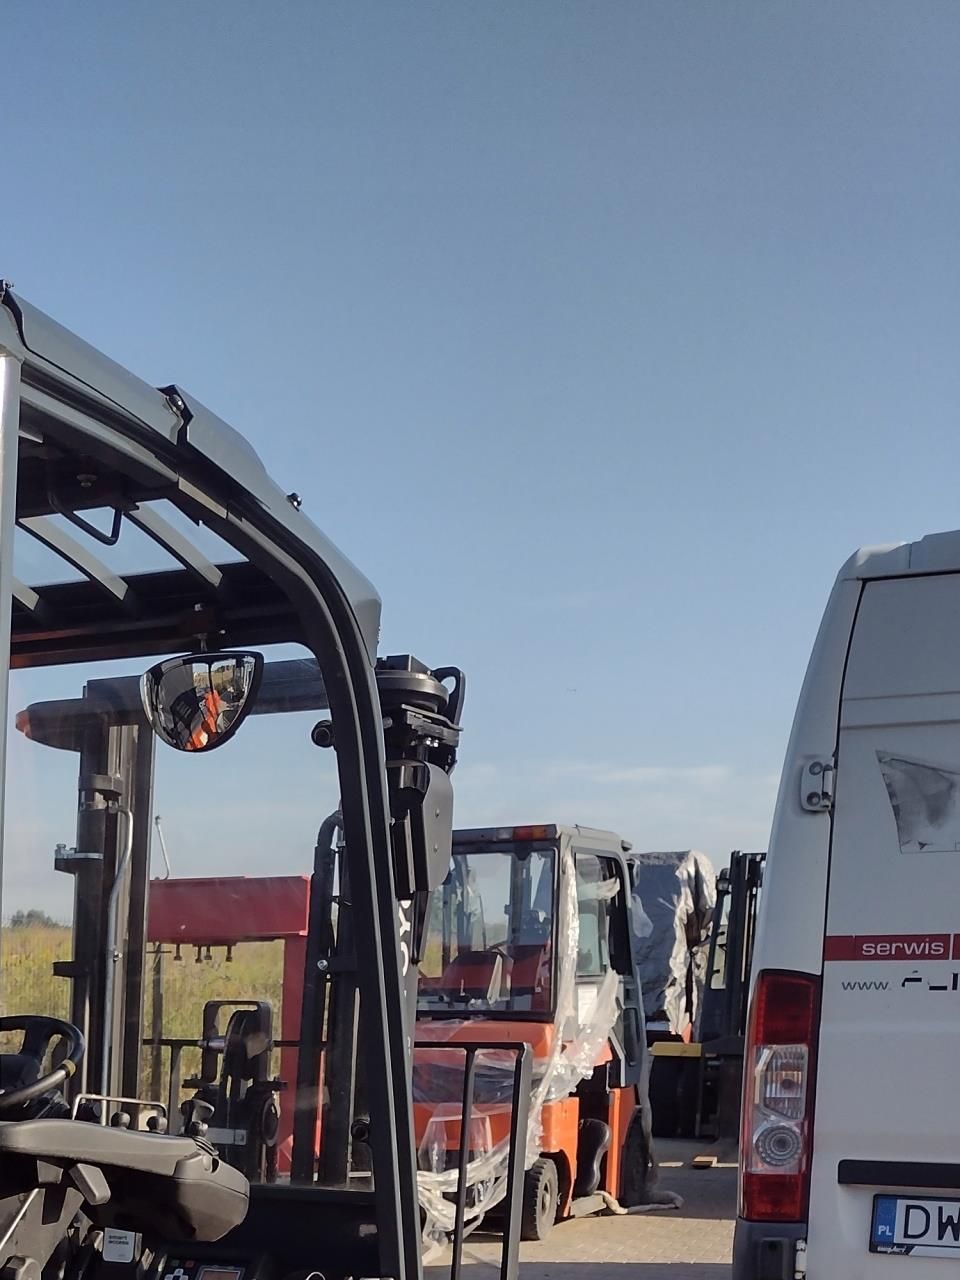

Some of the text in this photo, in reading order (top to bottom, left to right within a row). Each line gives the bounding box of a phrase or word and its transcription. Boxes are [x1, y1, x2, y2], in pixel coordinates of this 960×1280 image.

[861, 938, 945, 956] serwis
[878, 1224, 893, 1236] PL
[903, 1204, 960, 1242] DW
